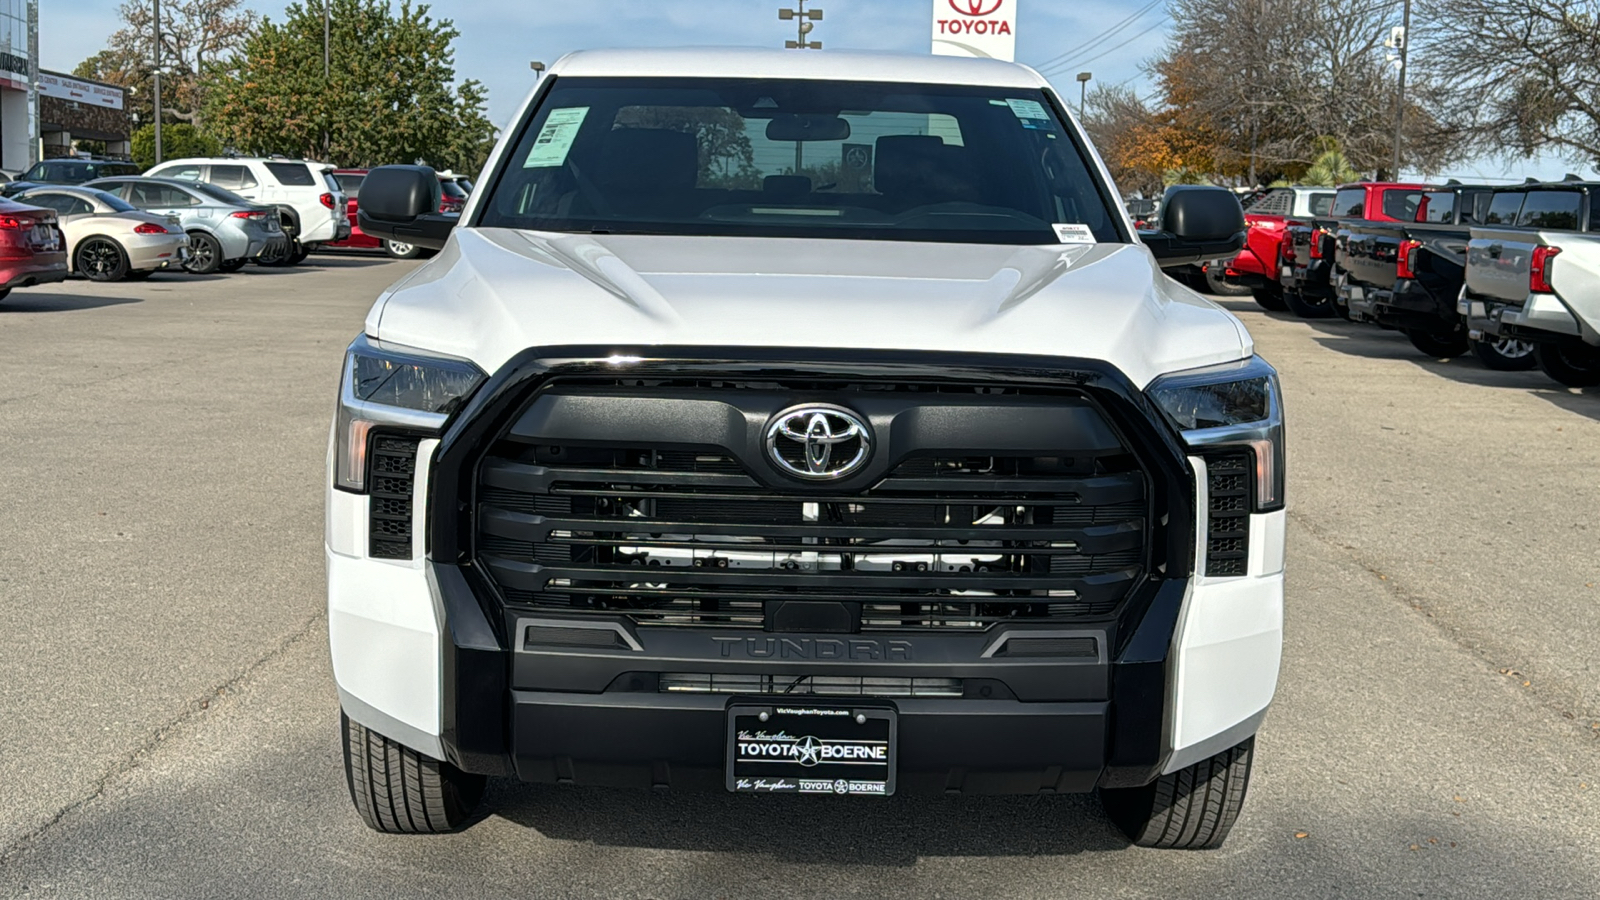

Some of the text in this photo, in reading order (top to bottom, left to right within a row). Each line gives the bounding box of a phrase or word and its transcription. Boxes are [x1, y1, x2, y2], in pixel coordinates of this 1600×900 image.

[937, 19, 1011, 35] TOYOTA
[711, 636, 913, 661] TUNDRA
[776, 707, 850, 716] VicVaughanToyota.com
[737, 730, 797, 742] Vic Vaughan
[738, 743, 799, 756] TOYOTA
[821, 745, 887, 759] BOERNE
[736, 778, 752, 790] Vic
[753, 778, 796, 791] Vaughan
[799, 781, 834, 790] TOYOTA
[849, 782, 885, 792] BOERNE
